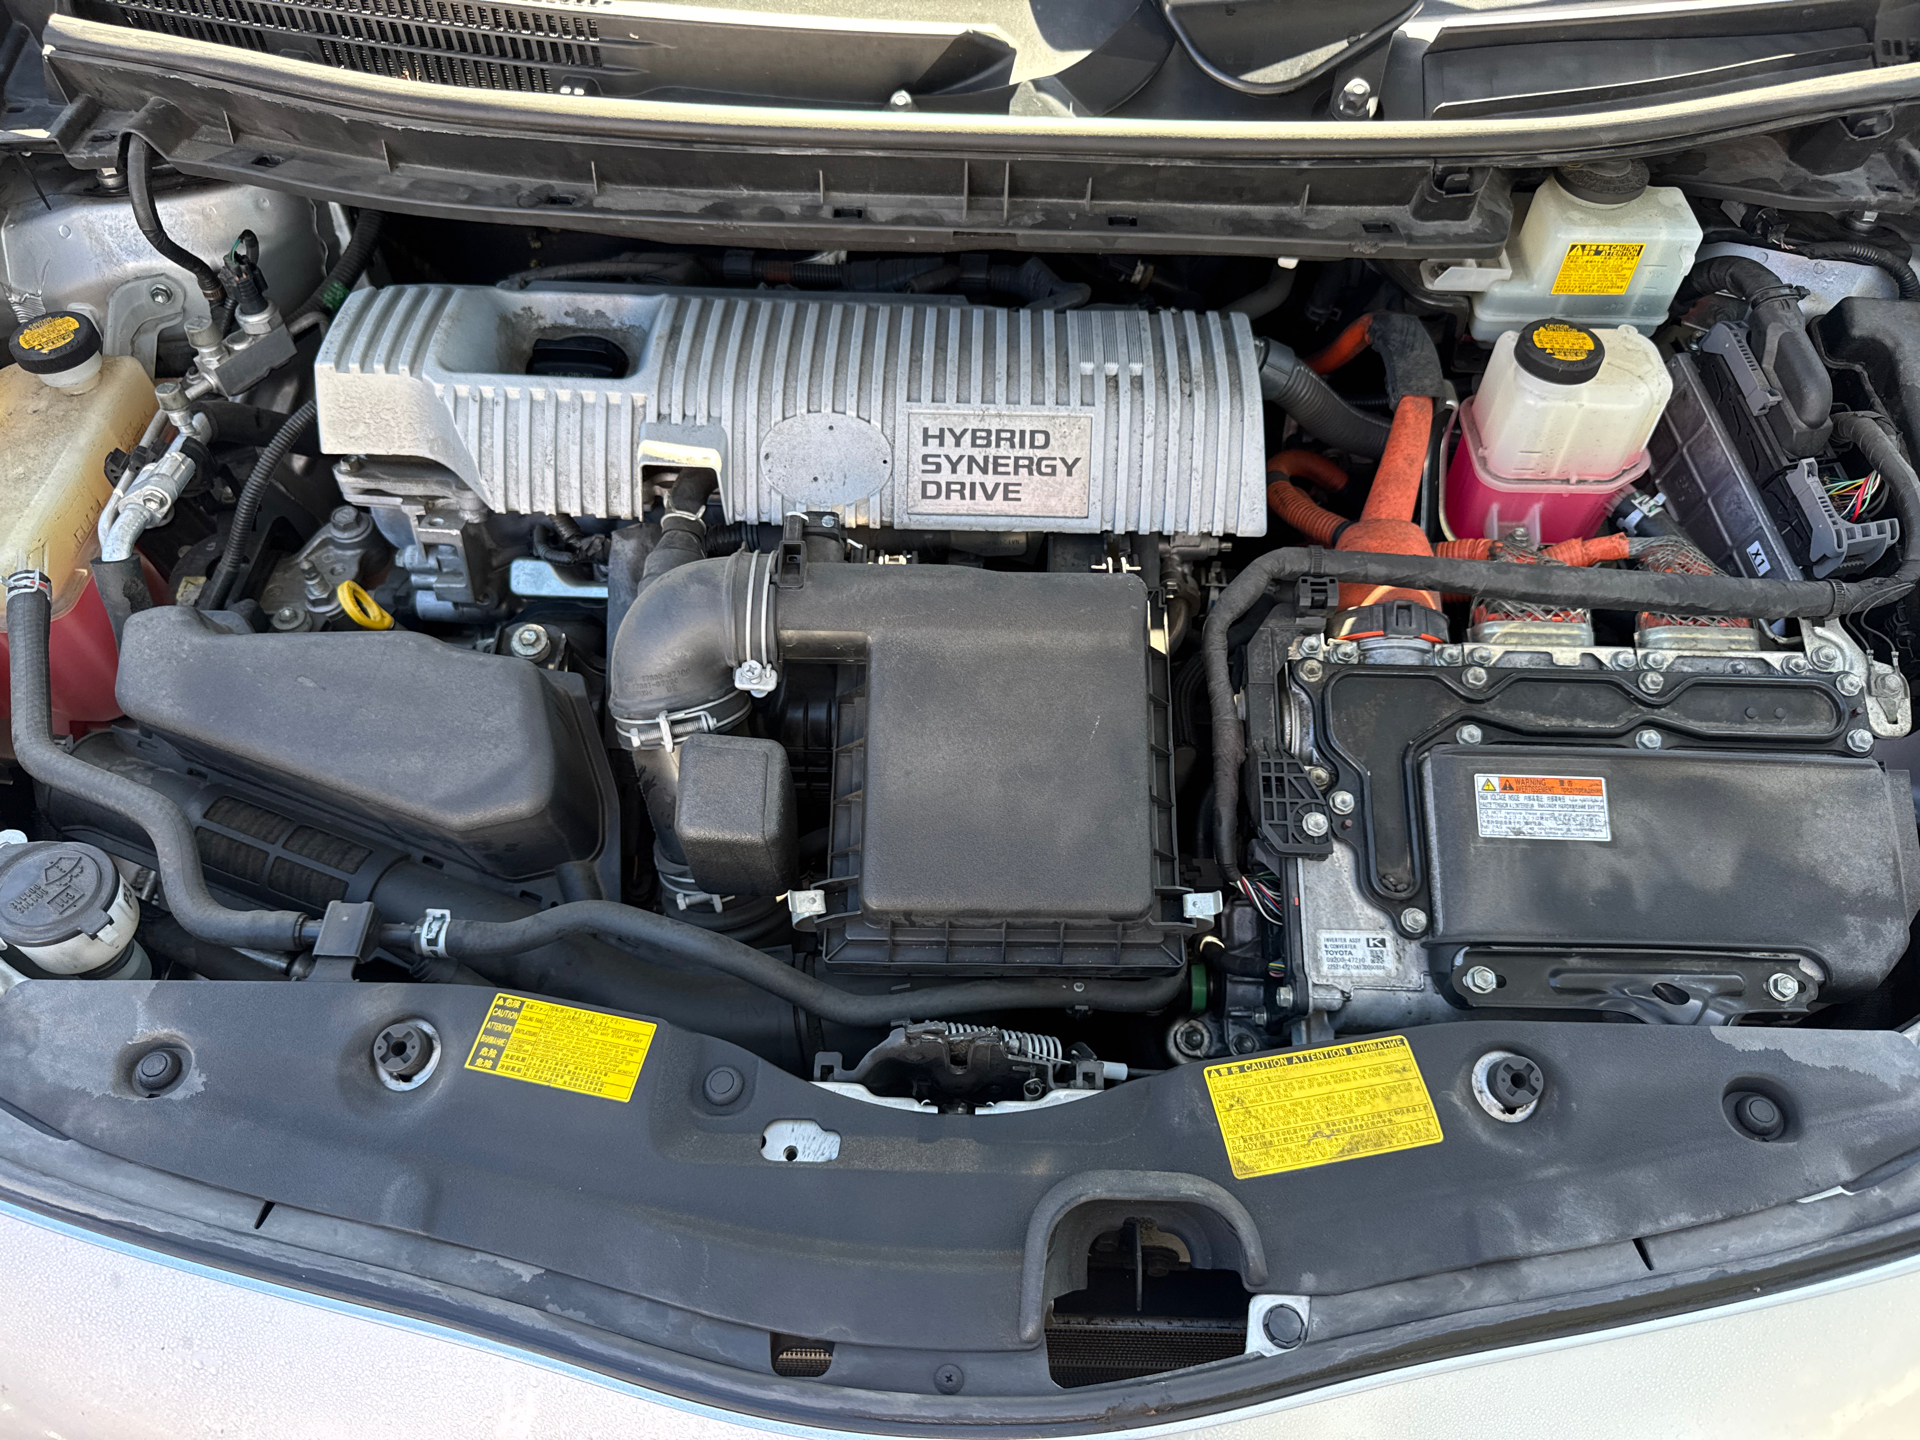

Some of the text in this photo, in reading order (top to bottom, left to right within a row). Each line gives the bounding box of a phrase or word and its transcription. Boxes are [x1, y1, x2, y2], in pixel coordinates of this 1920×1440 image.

[922, 427, 1050, 450] HYBRID
[922, 454, 1082, 477] SYNERGY
[921, 480, 1022, 502] DRIVE
[1751, 548, 1765, 567] X1
[491, 1007, 520, 1019] CAUTION
[485, 1020, 514, 1032] ATTENTION
[1349, 1038, 1403, 1054] ВНИМАНИЕ
[1243, 1047, 1347, 1072] CAUTION ATTENTION
